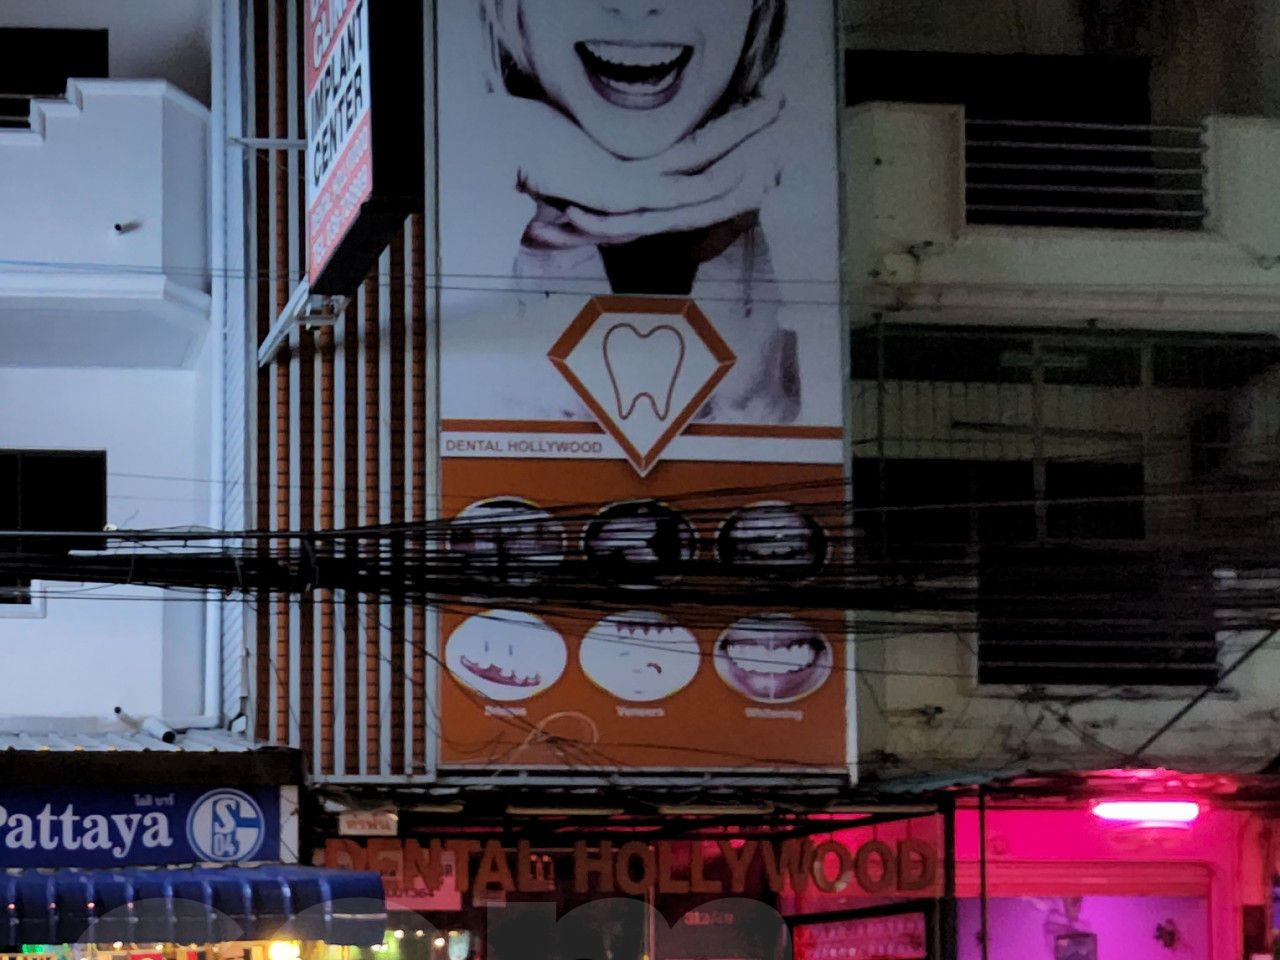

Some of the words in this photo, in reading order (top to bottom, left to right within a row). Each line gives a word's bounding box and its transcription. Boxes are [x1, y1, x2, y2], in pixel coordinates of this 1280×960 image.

[311, 0, 363, 142] IMPLANT
[314, 64, 362, 187] CENTER
[445, 439, 504, 452] DENTAL
[507, 440, 603, 454] HOLLYWOOD
[324, 838, 556, 894] DENTAL
[573, 837, 937, 897] HOLLYWOOD
